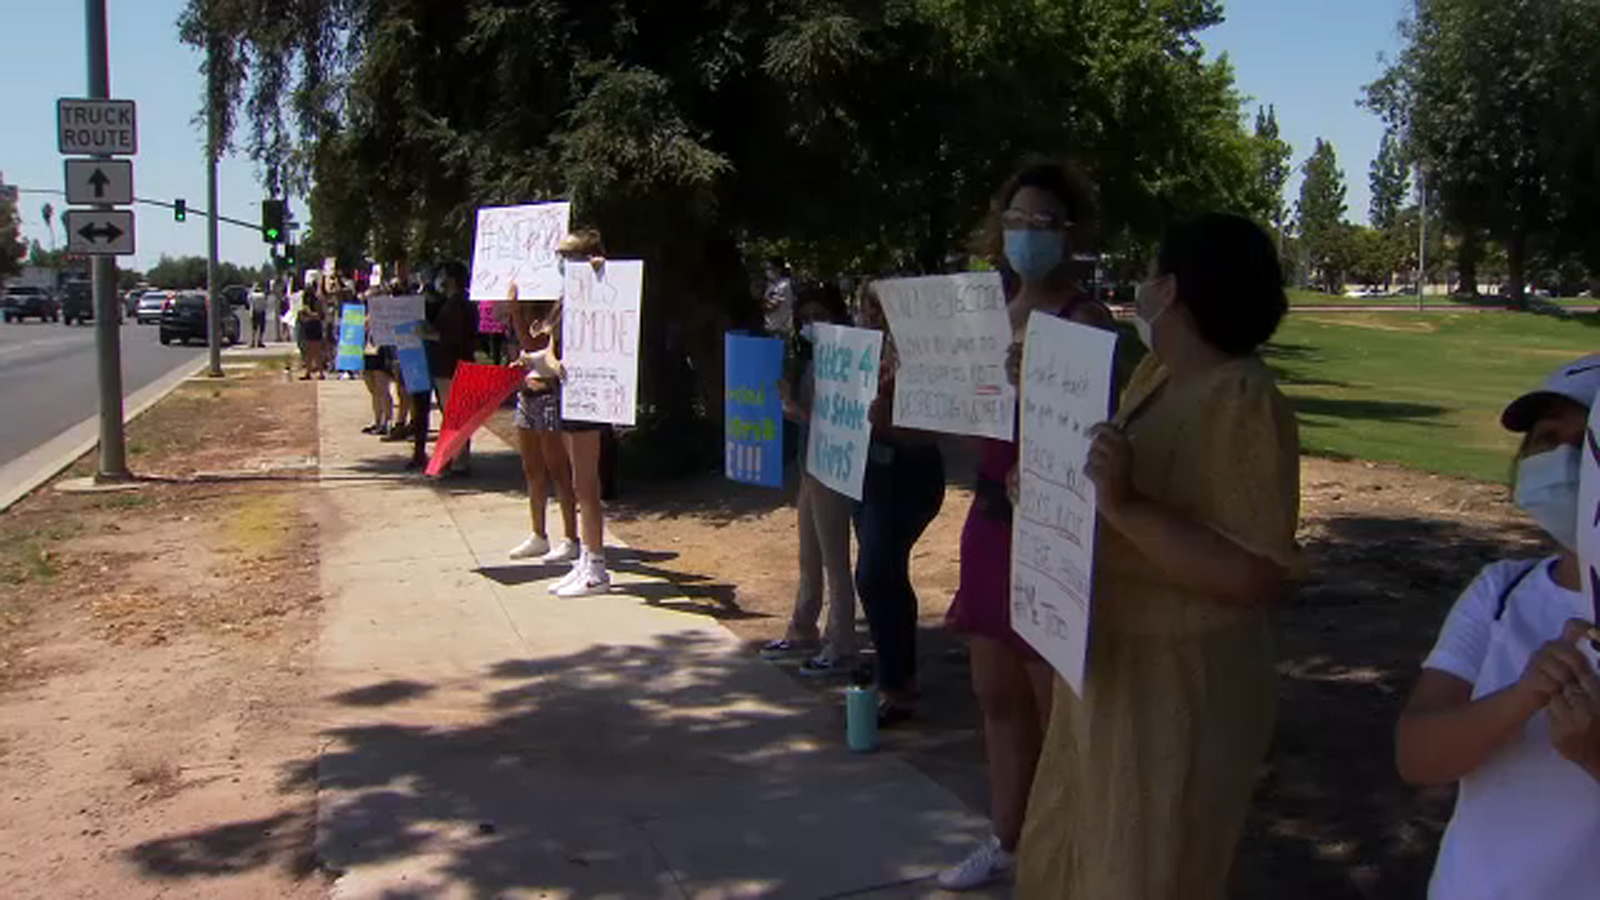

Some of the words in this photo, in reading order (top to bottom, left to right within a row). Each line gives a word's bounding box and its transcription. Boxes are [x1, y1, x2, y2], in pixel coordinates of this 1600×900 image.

[62, 106, 131, 125] TRUCK
[64, 129, 131, 147] ROUTE
[858, 342, 873, 388] 4
